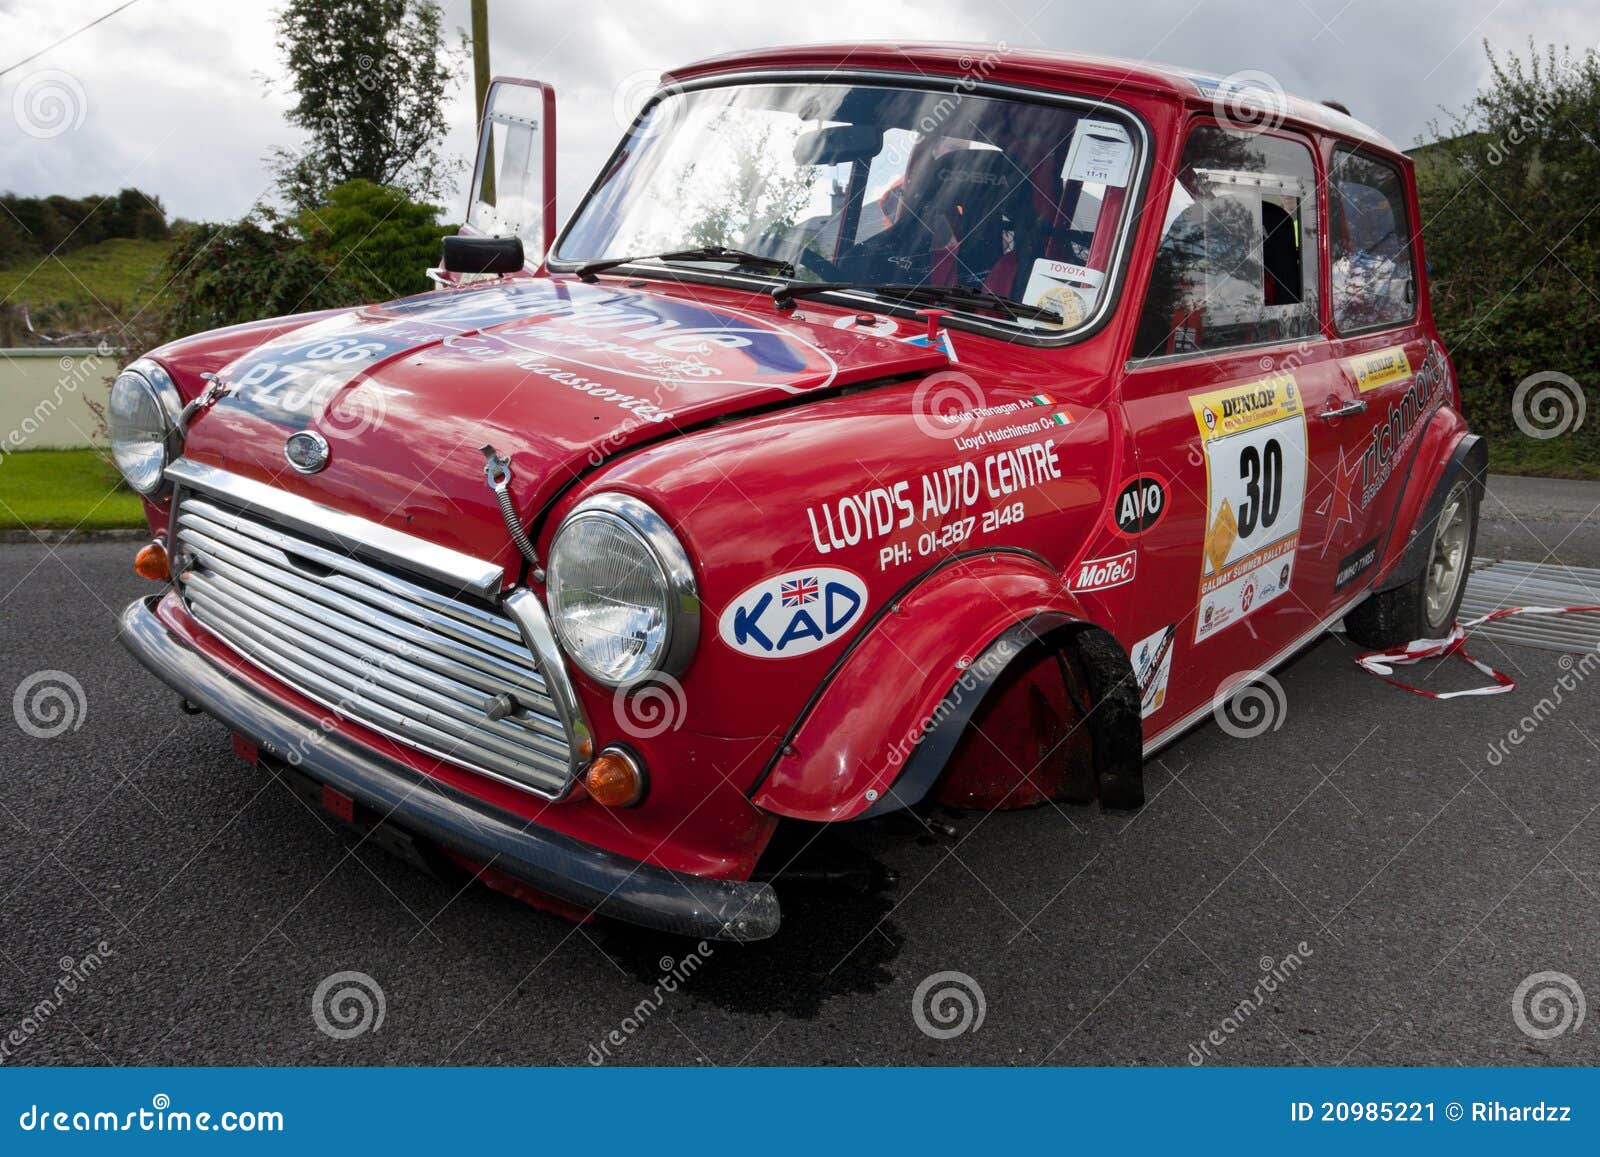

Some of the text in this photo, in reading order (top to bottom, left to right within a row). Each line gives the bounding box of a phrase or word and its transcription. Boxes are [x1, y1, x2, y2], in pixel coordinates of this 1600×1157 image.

[1050, 262, 1087, 277] TOYOTA
[940, 408, 973, 426] Kevin
[973, 400, 1019, 421] Flanagan
[1222, 390, 1275, 419] DUNLOP
[954, 431, 986, 451] Lloyd
[986, 421, 1040, 443] Hutchinson
[807, 439, 1062, 554] LLOYD'S AUTO CENTRE
[1119, 484, 1161, 525] AVO
[1238, 438, 1283, 538] 30
[879, 502, 1025, 572] PH: 01-287 2148
[1076, 556, 1133, 589] MoTeC
[1201, 573, 1232, 595] GALWAY
[1232, 556, 1263, 579] SUMMER
[1263, 547, 1282, 564] RALLY
[734, 582, 861, 651] KAD
